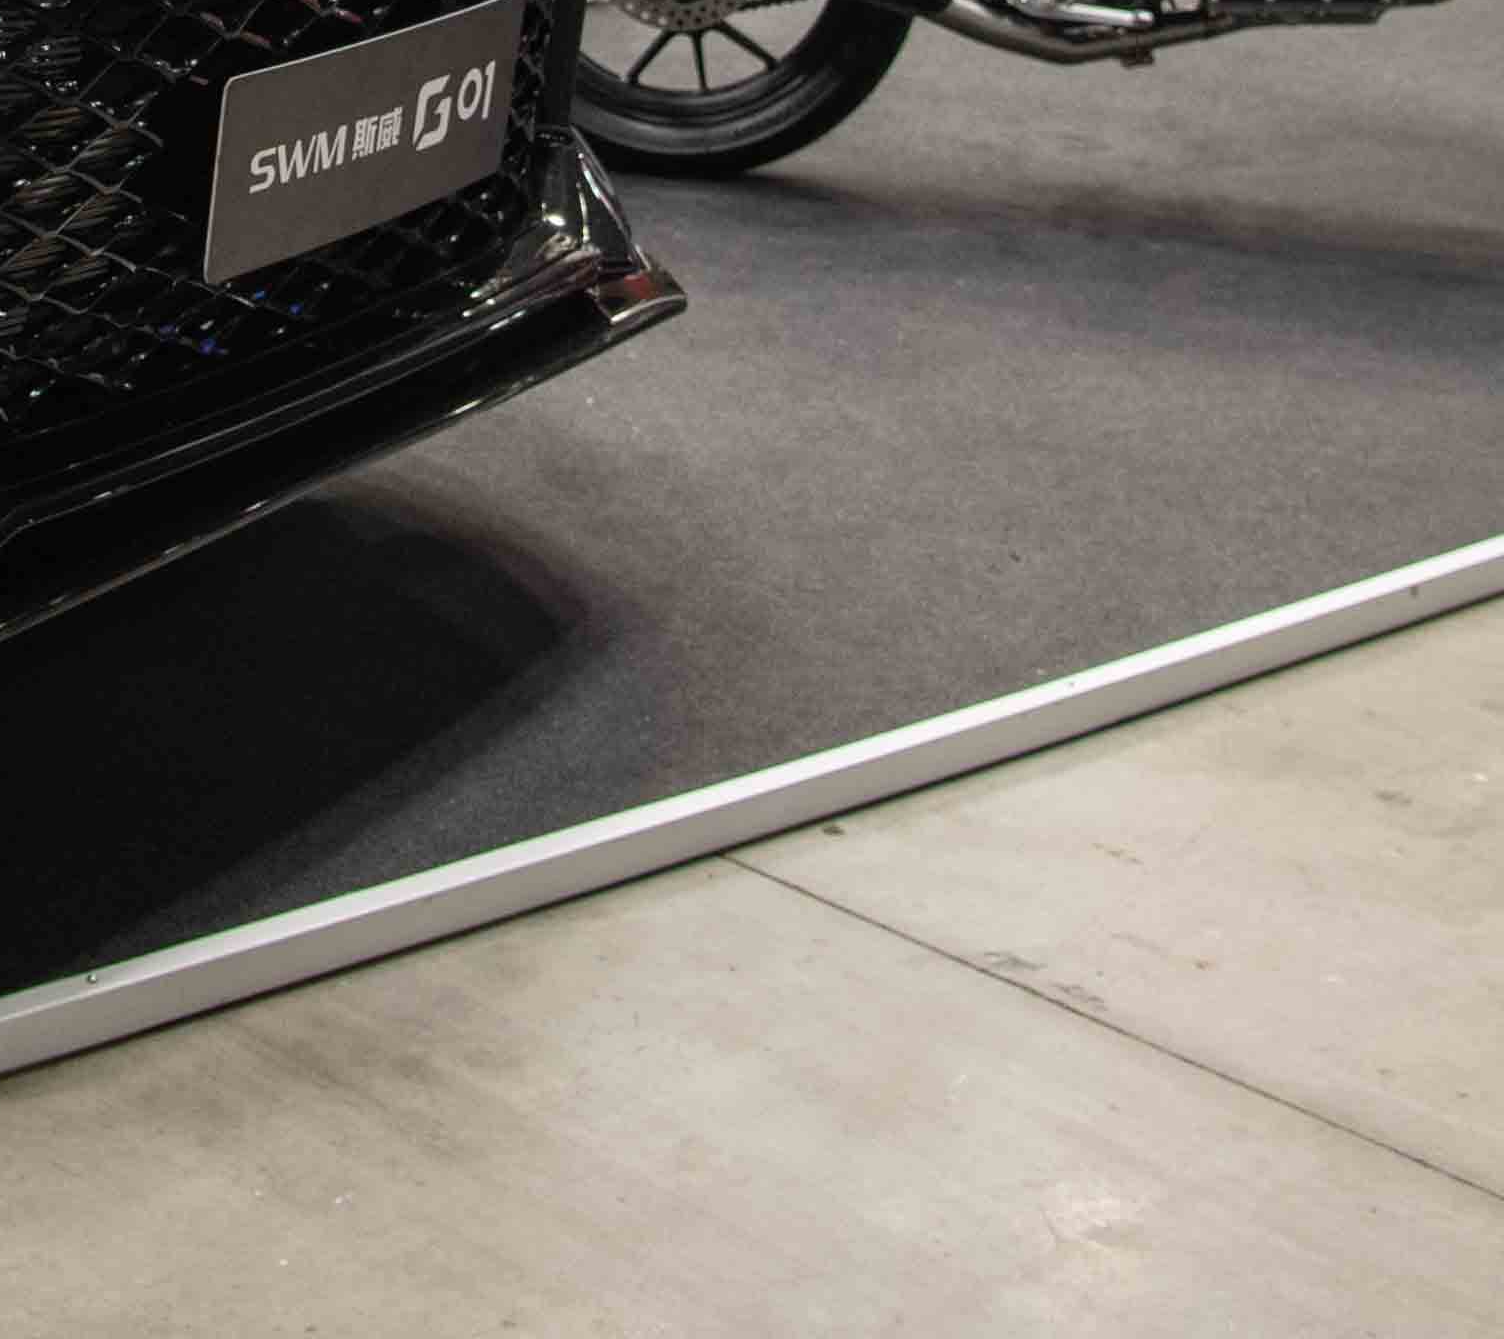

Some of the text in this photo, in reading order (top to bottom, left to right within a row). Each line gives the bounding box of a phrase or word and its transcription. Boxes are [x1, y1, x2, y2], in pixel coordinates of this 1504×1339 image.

[248, 59, 497, 195] SWM 斯威 G01
